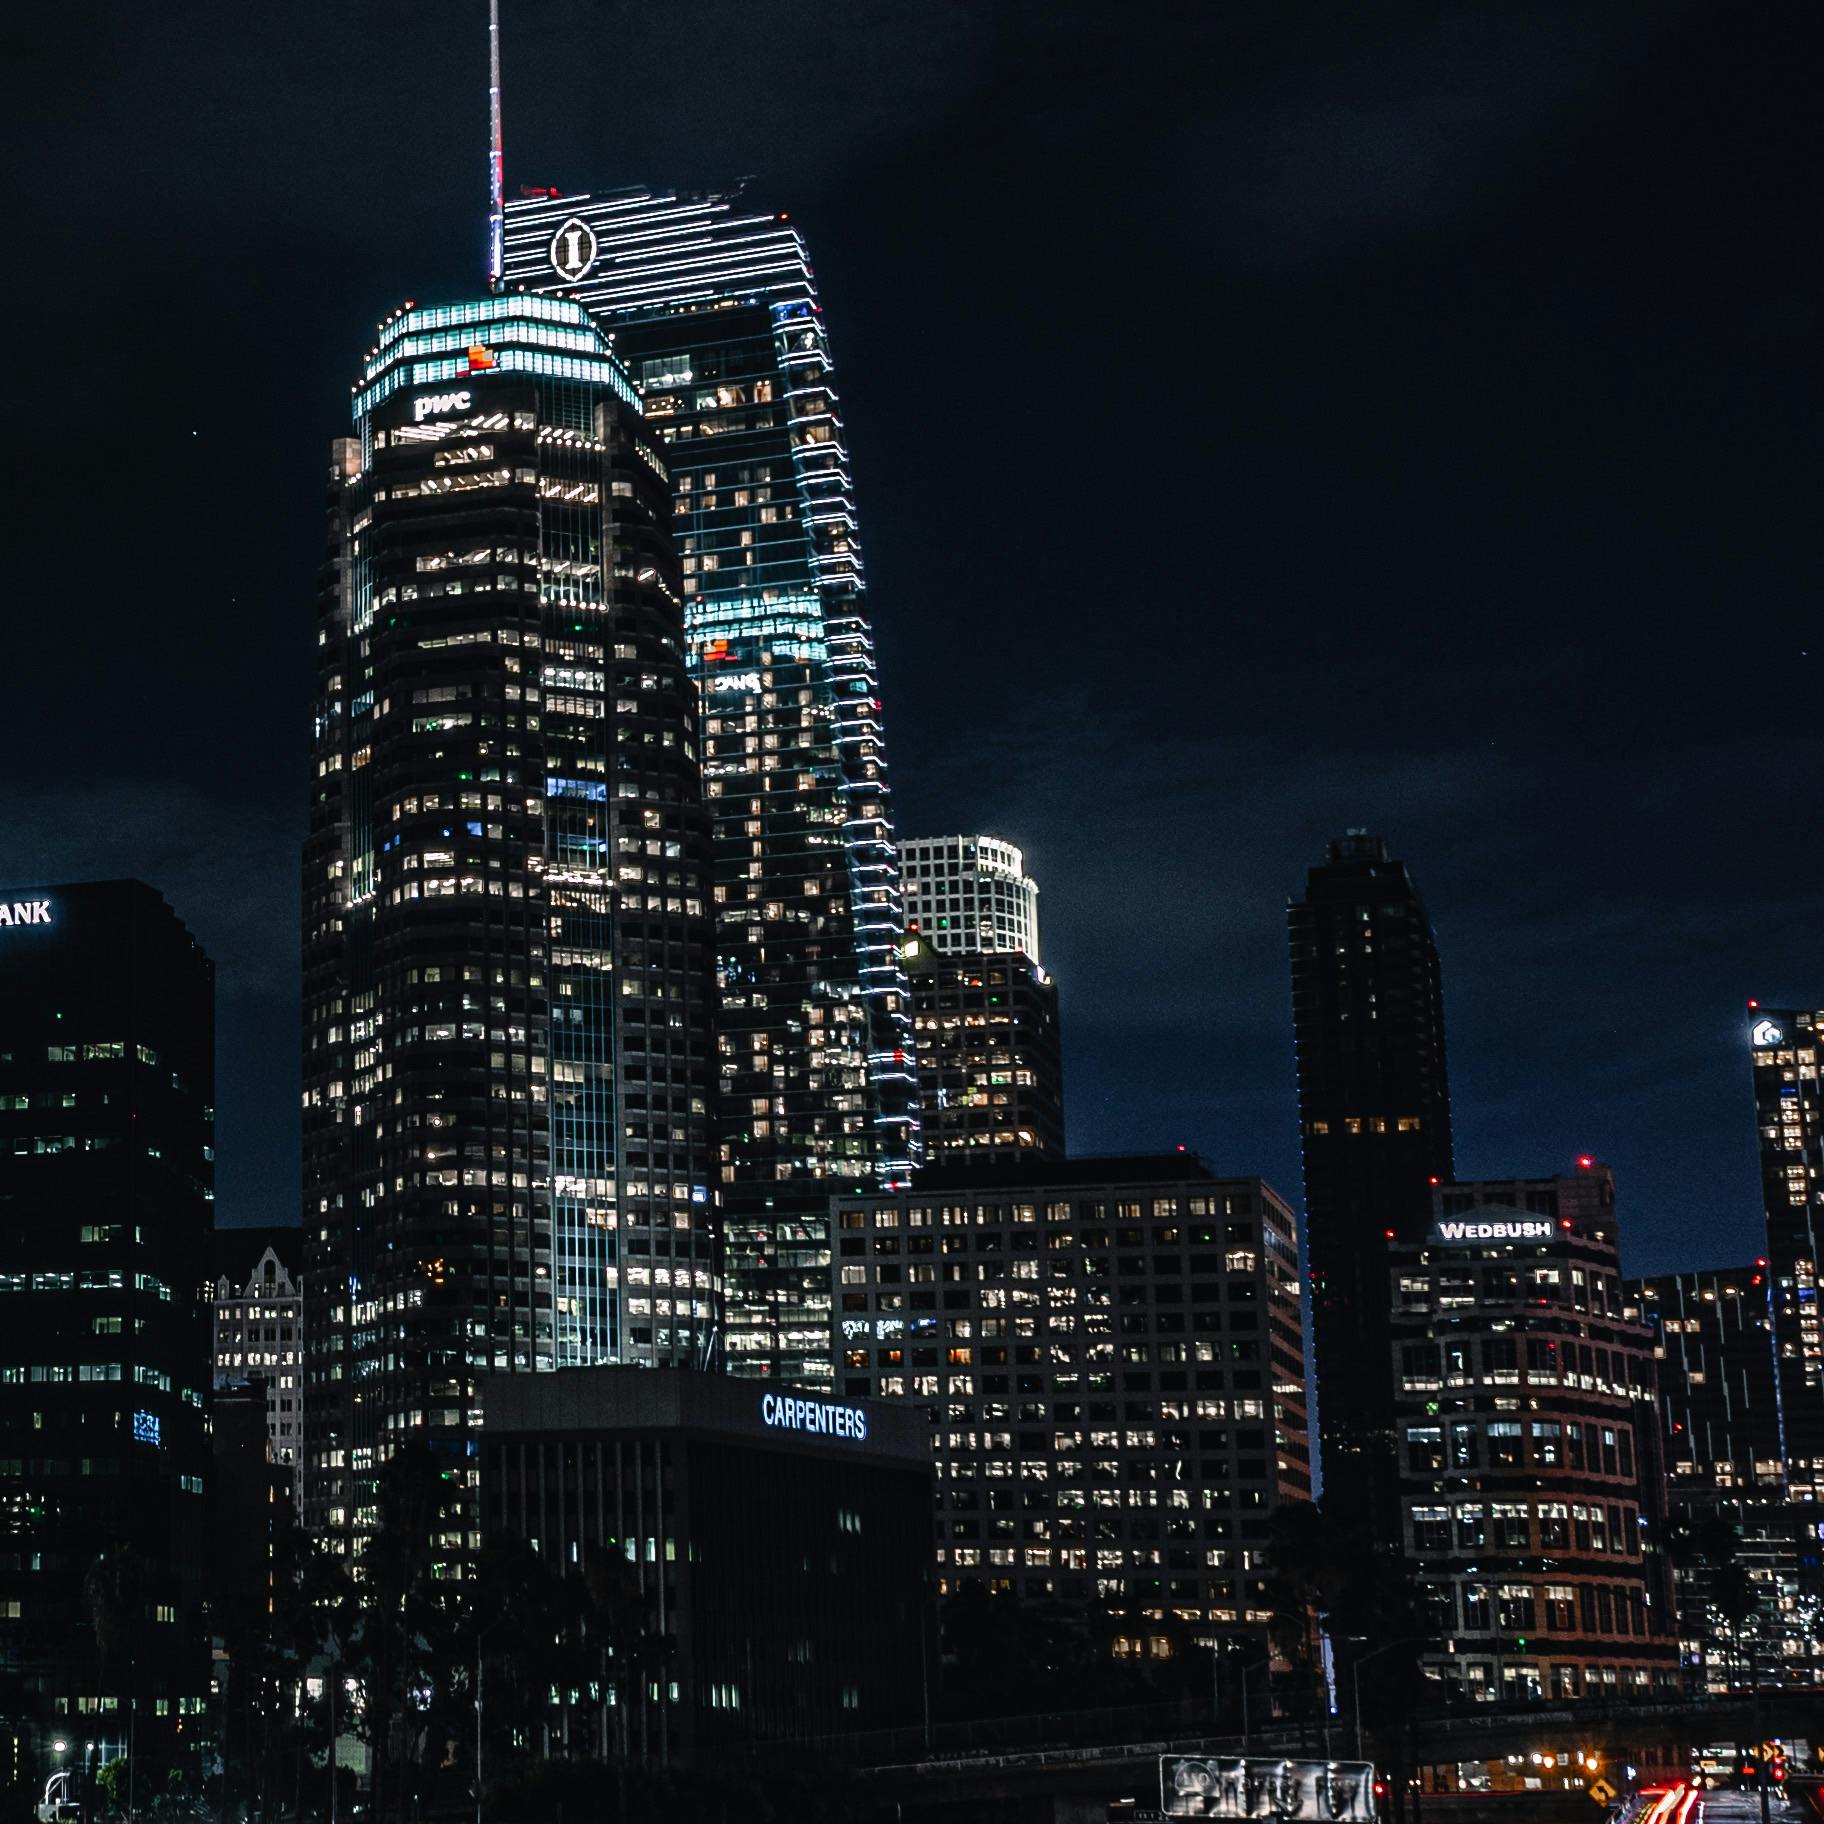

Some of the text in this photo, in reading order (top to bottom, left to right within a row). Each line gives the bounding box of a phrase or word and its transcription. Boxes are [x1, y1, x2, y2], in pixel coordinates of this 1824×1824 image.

[413, 391, 471, 422] pwc
[1439, 1222, 1552, 1240] WEDBUSH
[763, 1393, 867, 1440] CARPENTERS
